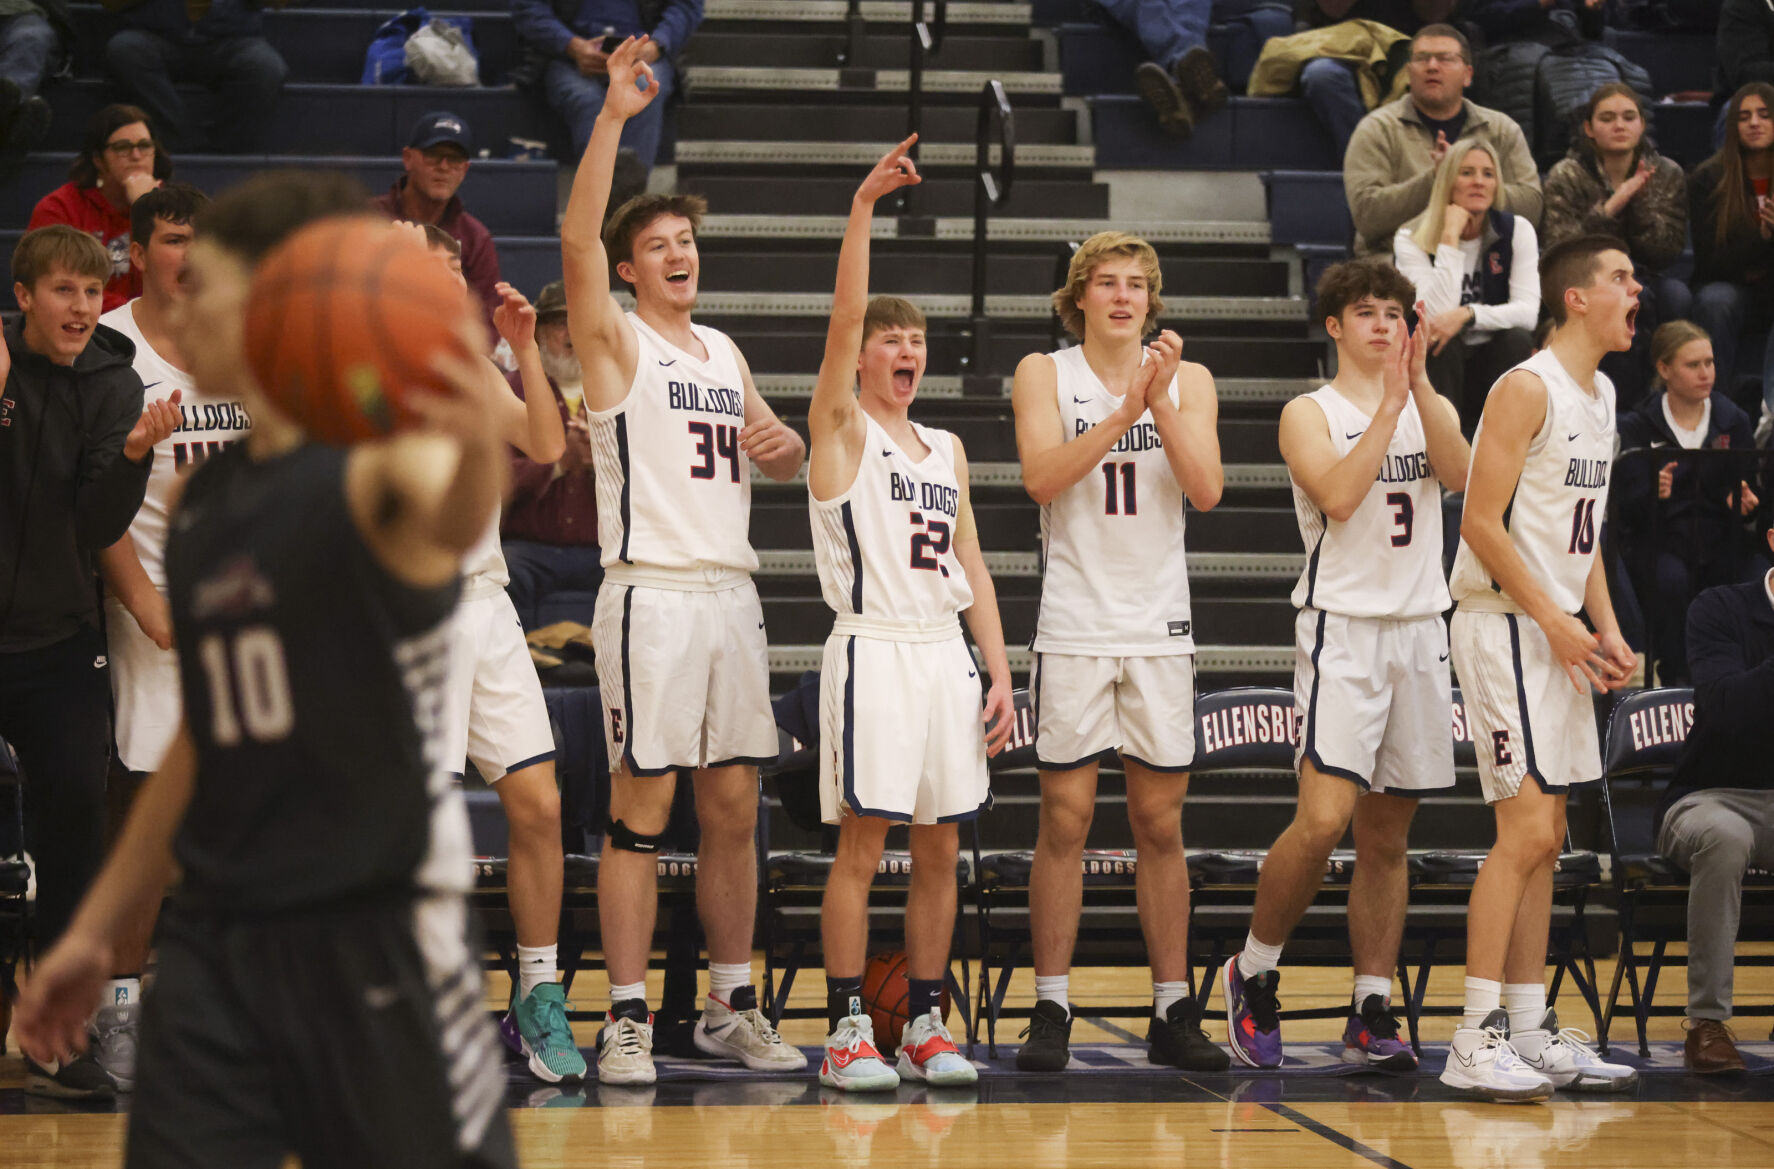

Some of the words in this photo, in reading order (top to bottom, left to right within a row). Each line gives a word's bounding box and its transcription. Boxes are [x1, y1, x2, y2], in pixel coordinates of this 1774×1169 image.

[688, 420, 741, 484] 34
[1102, 461, 1137, 516] 11
[1386, 491, 1414, 548] 3
[200, 627, 295, 747] 10
[610, 708, 624, 743] E
[1491, 730, 1513, 767] E
